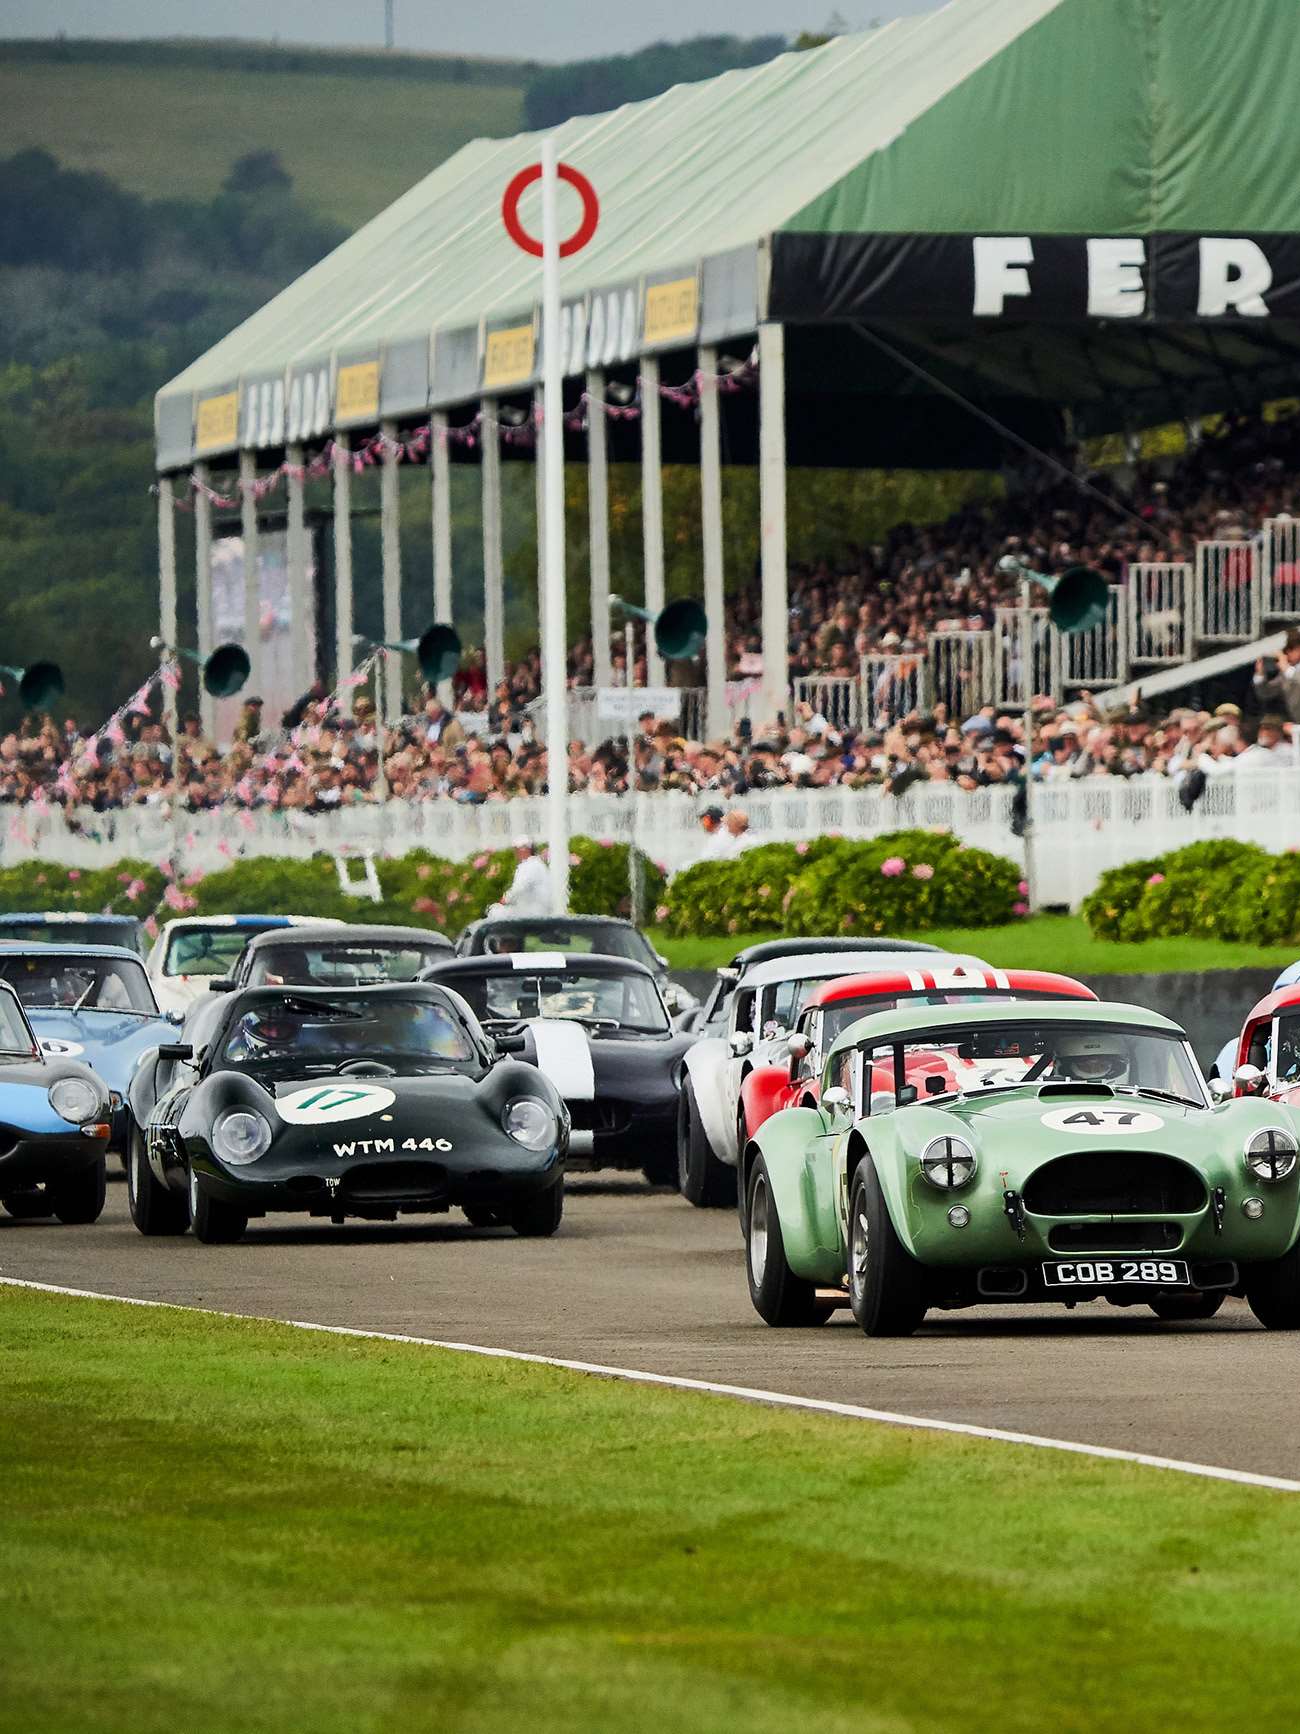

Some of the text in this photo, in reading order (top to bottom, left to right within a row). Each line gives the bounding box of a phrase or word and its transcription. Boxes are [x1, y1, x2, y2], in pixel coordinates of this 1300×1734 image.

[296, 1088, 375, 1110] 17
[1062, 1111, 1141, 1126] 47
[333, 1137, 453, 1158] WTM 446
[325, 1177, 341, 1187] TOW
[1056, 1262, 1178, 1282] COB 289
